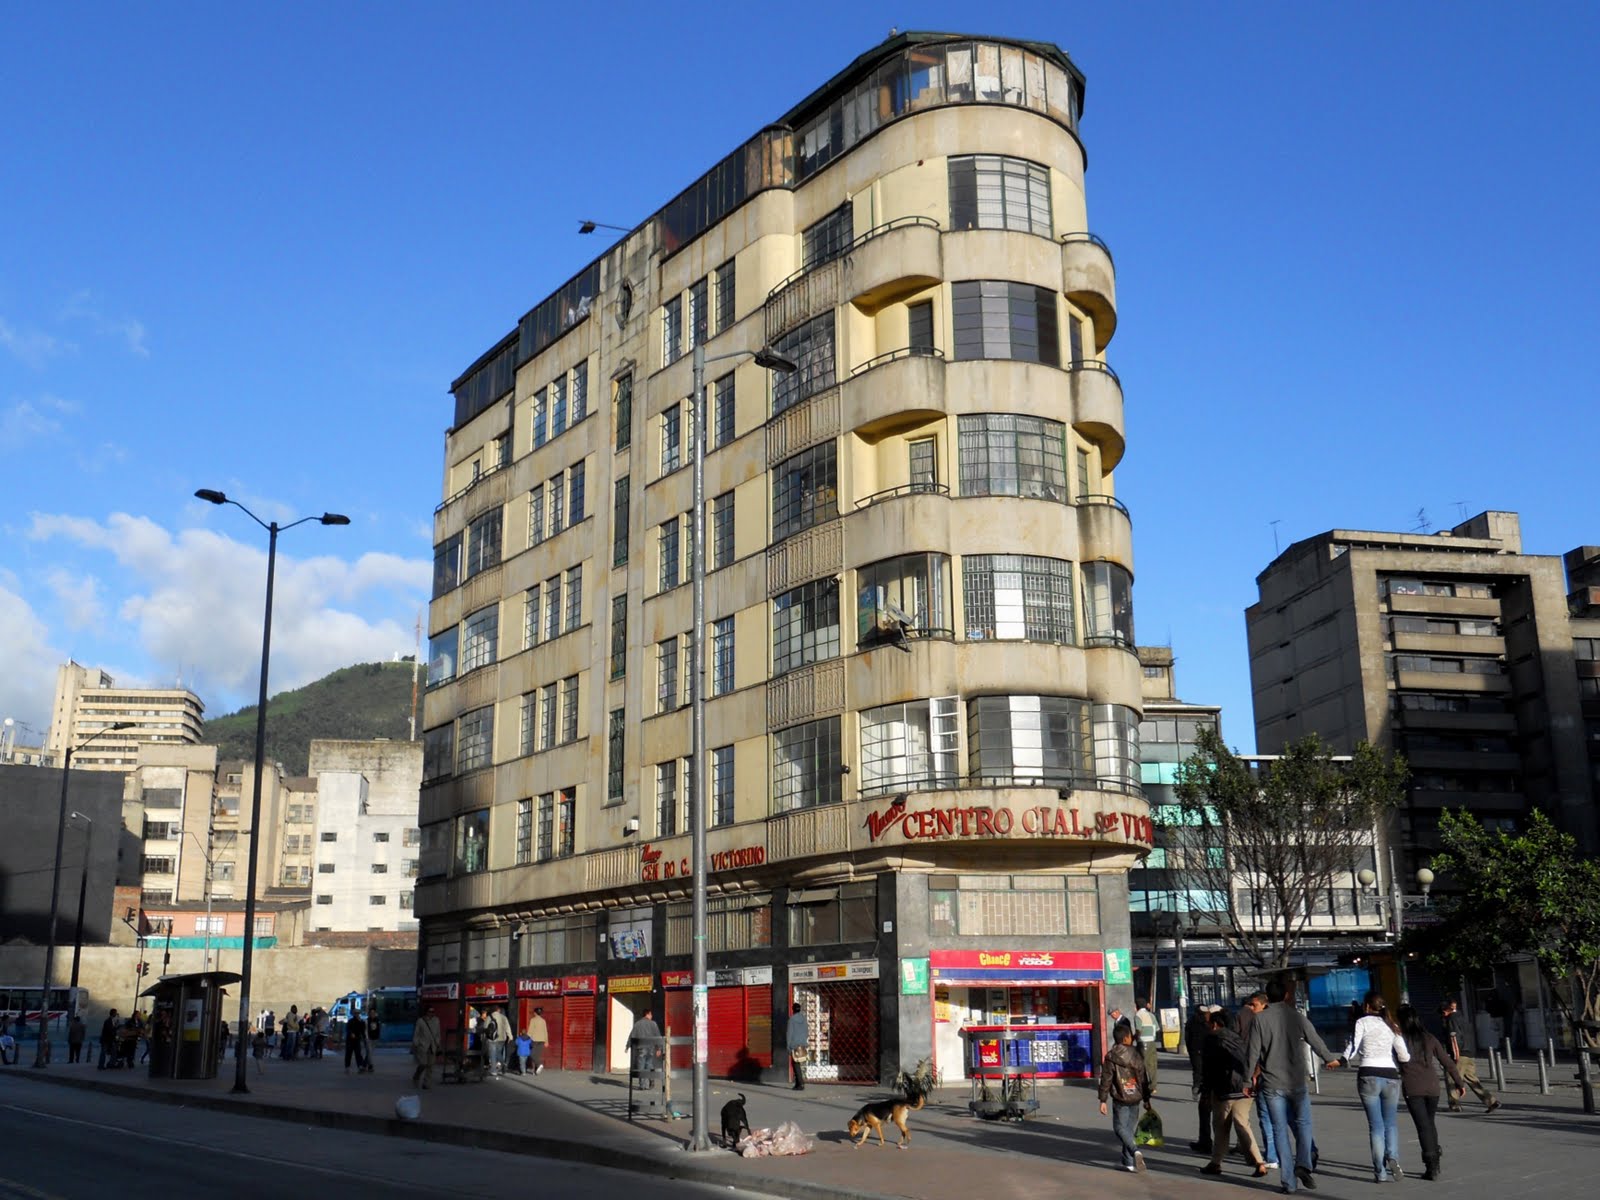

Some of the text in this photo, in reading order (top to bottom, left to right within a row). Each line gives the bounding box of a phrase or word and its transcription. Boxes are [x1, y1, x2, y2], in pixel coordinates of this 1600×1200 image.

[902, 805, 1014, 840] CENTRO
[1095, 811, 1119, 833] San
[711, 846, 765, 871] VICTORINO
[980, 953, 1011, 966] Chance
[609, 976, 649, 987] LIBRERIAS
